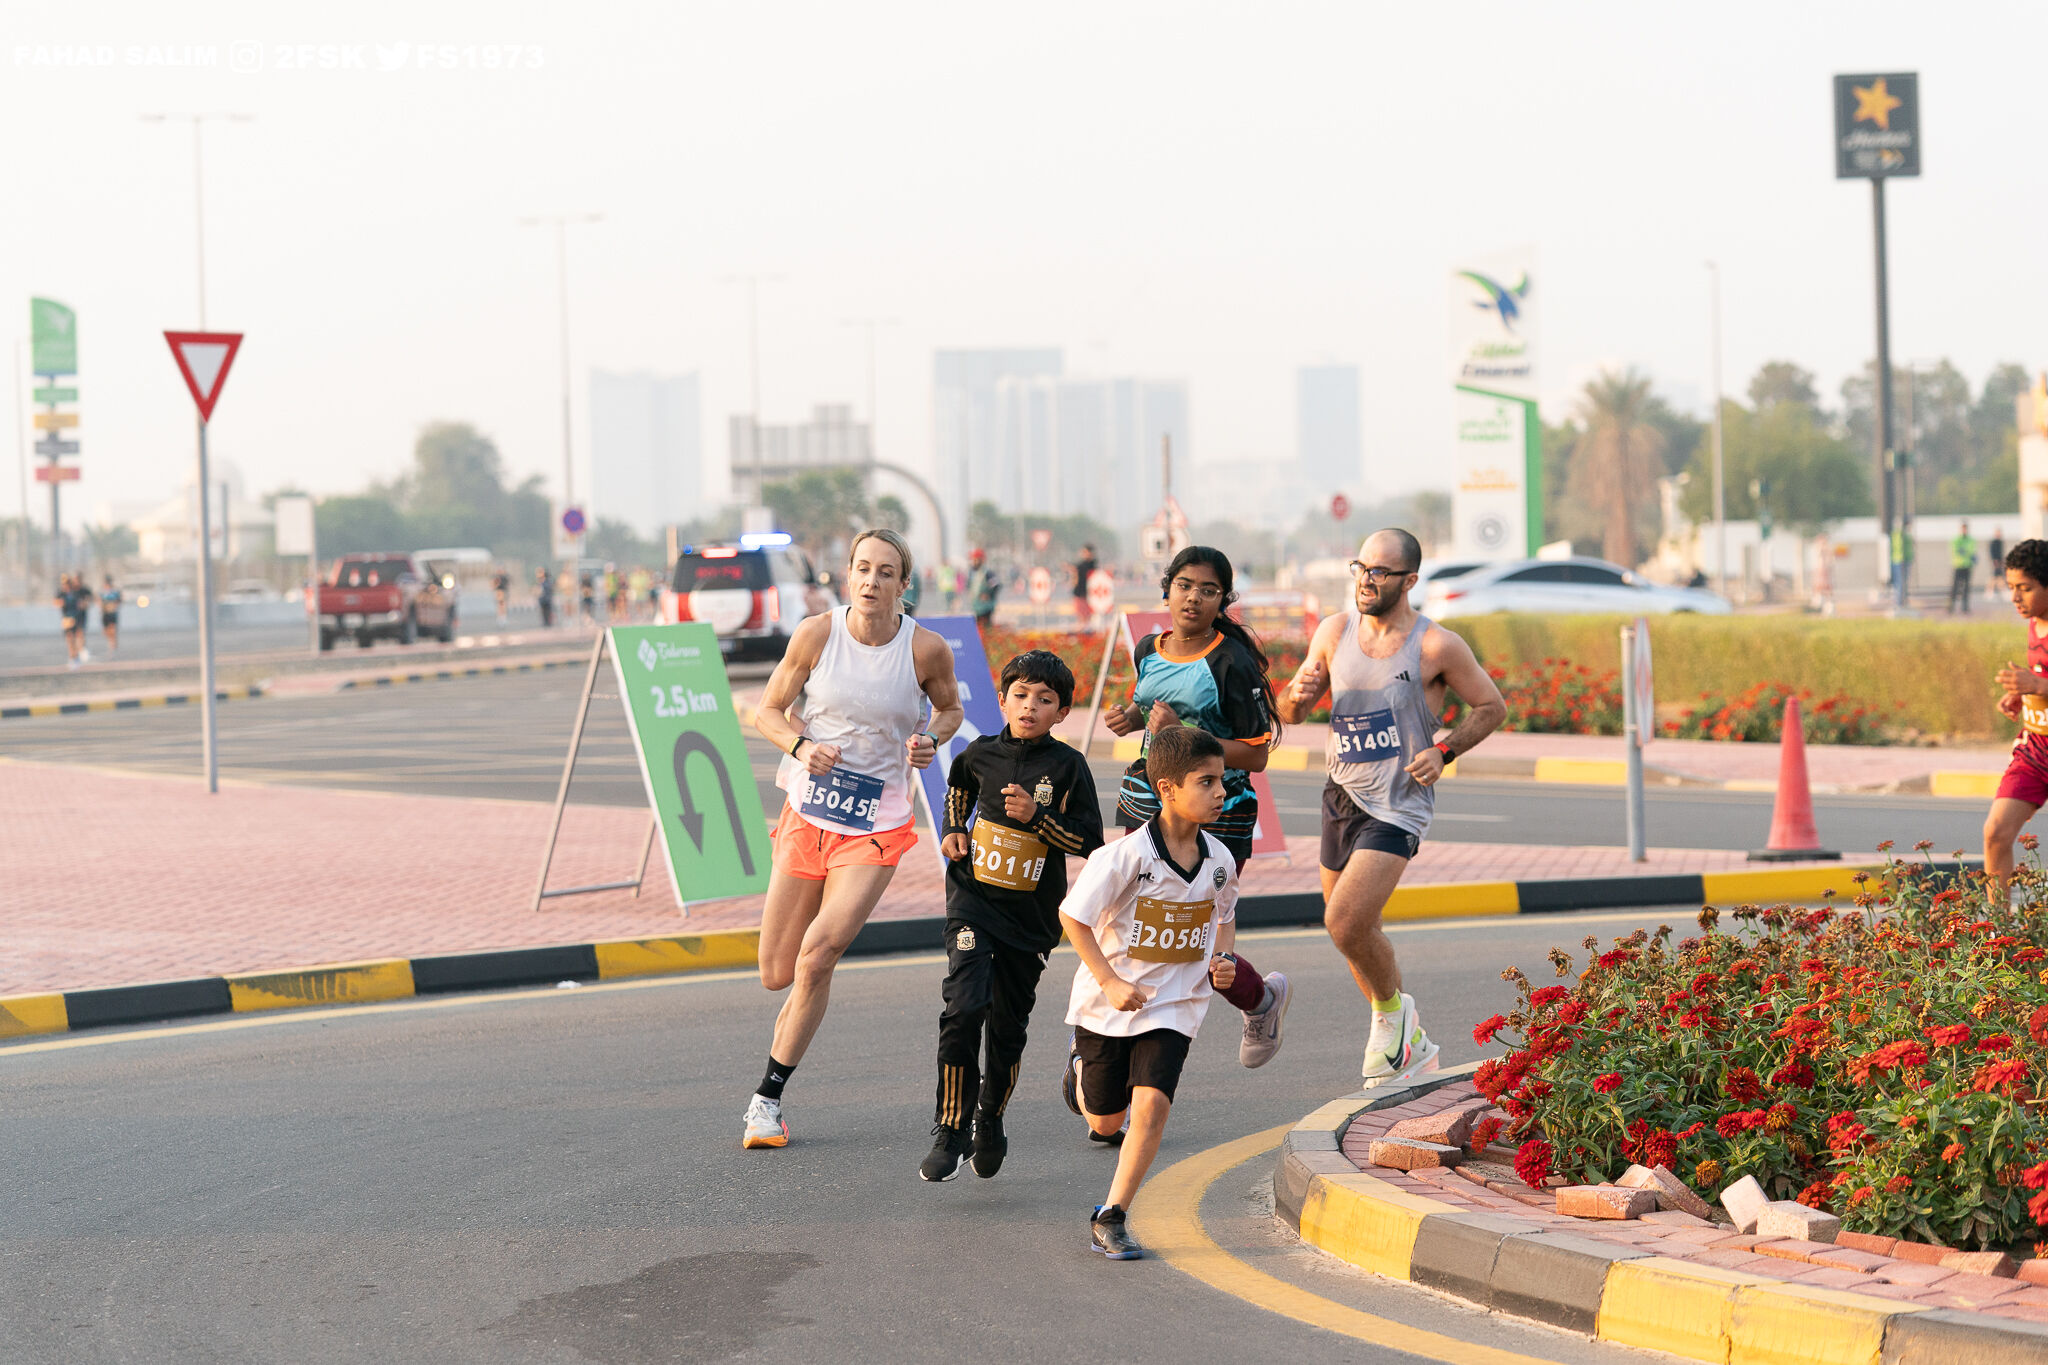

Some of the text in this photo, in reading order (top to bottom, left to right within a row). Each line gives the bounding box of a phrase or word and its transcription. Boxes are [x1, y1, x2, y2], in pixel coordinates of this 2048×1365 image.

[1342, 731, 1390, 752] 5140
[813, 787, 870, 816] 5045
[974, 845, 1032, 878] 2011
[1140, 925, 1202, 950] 2058
